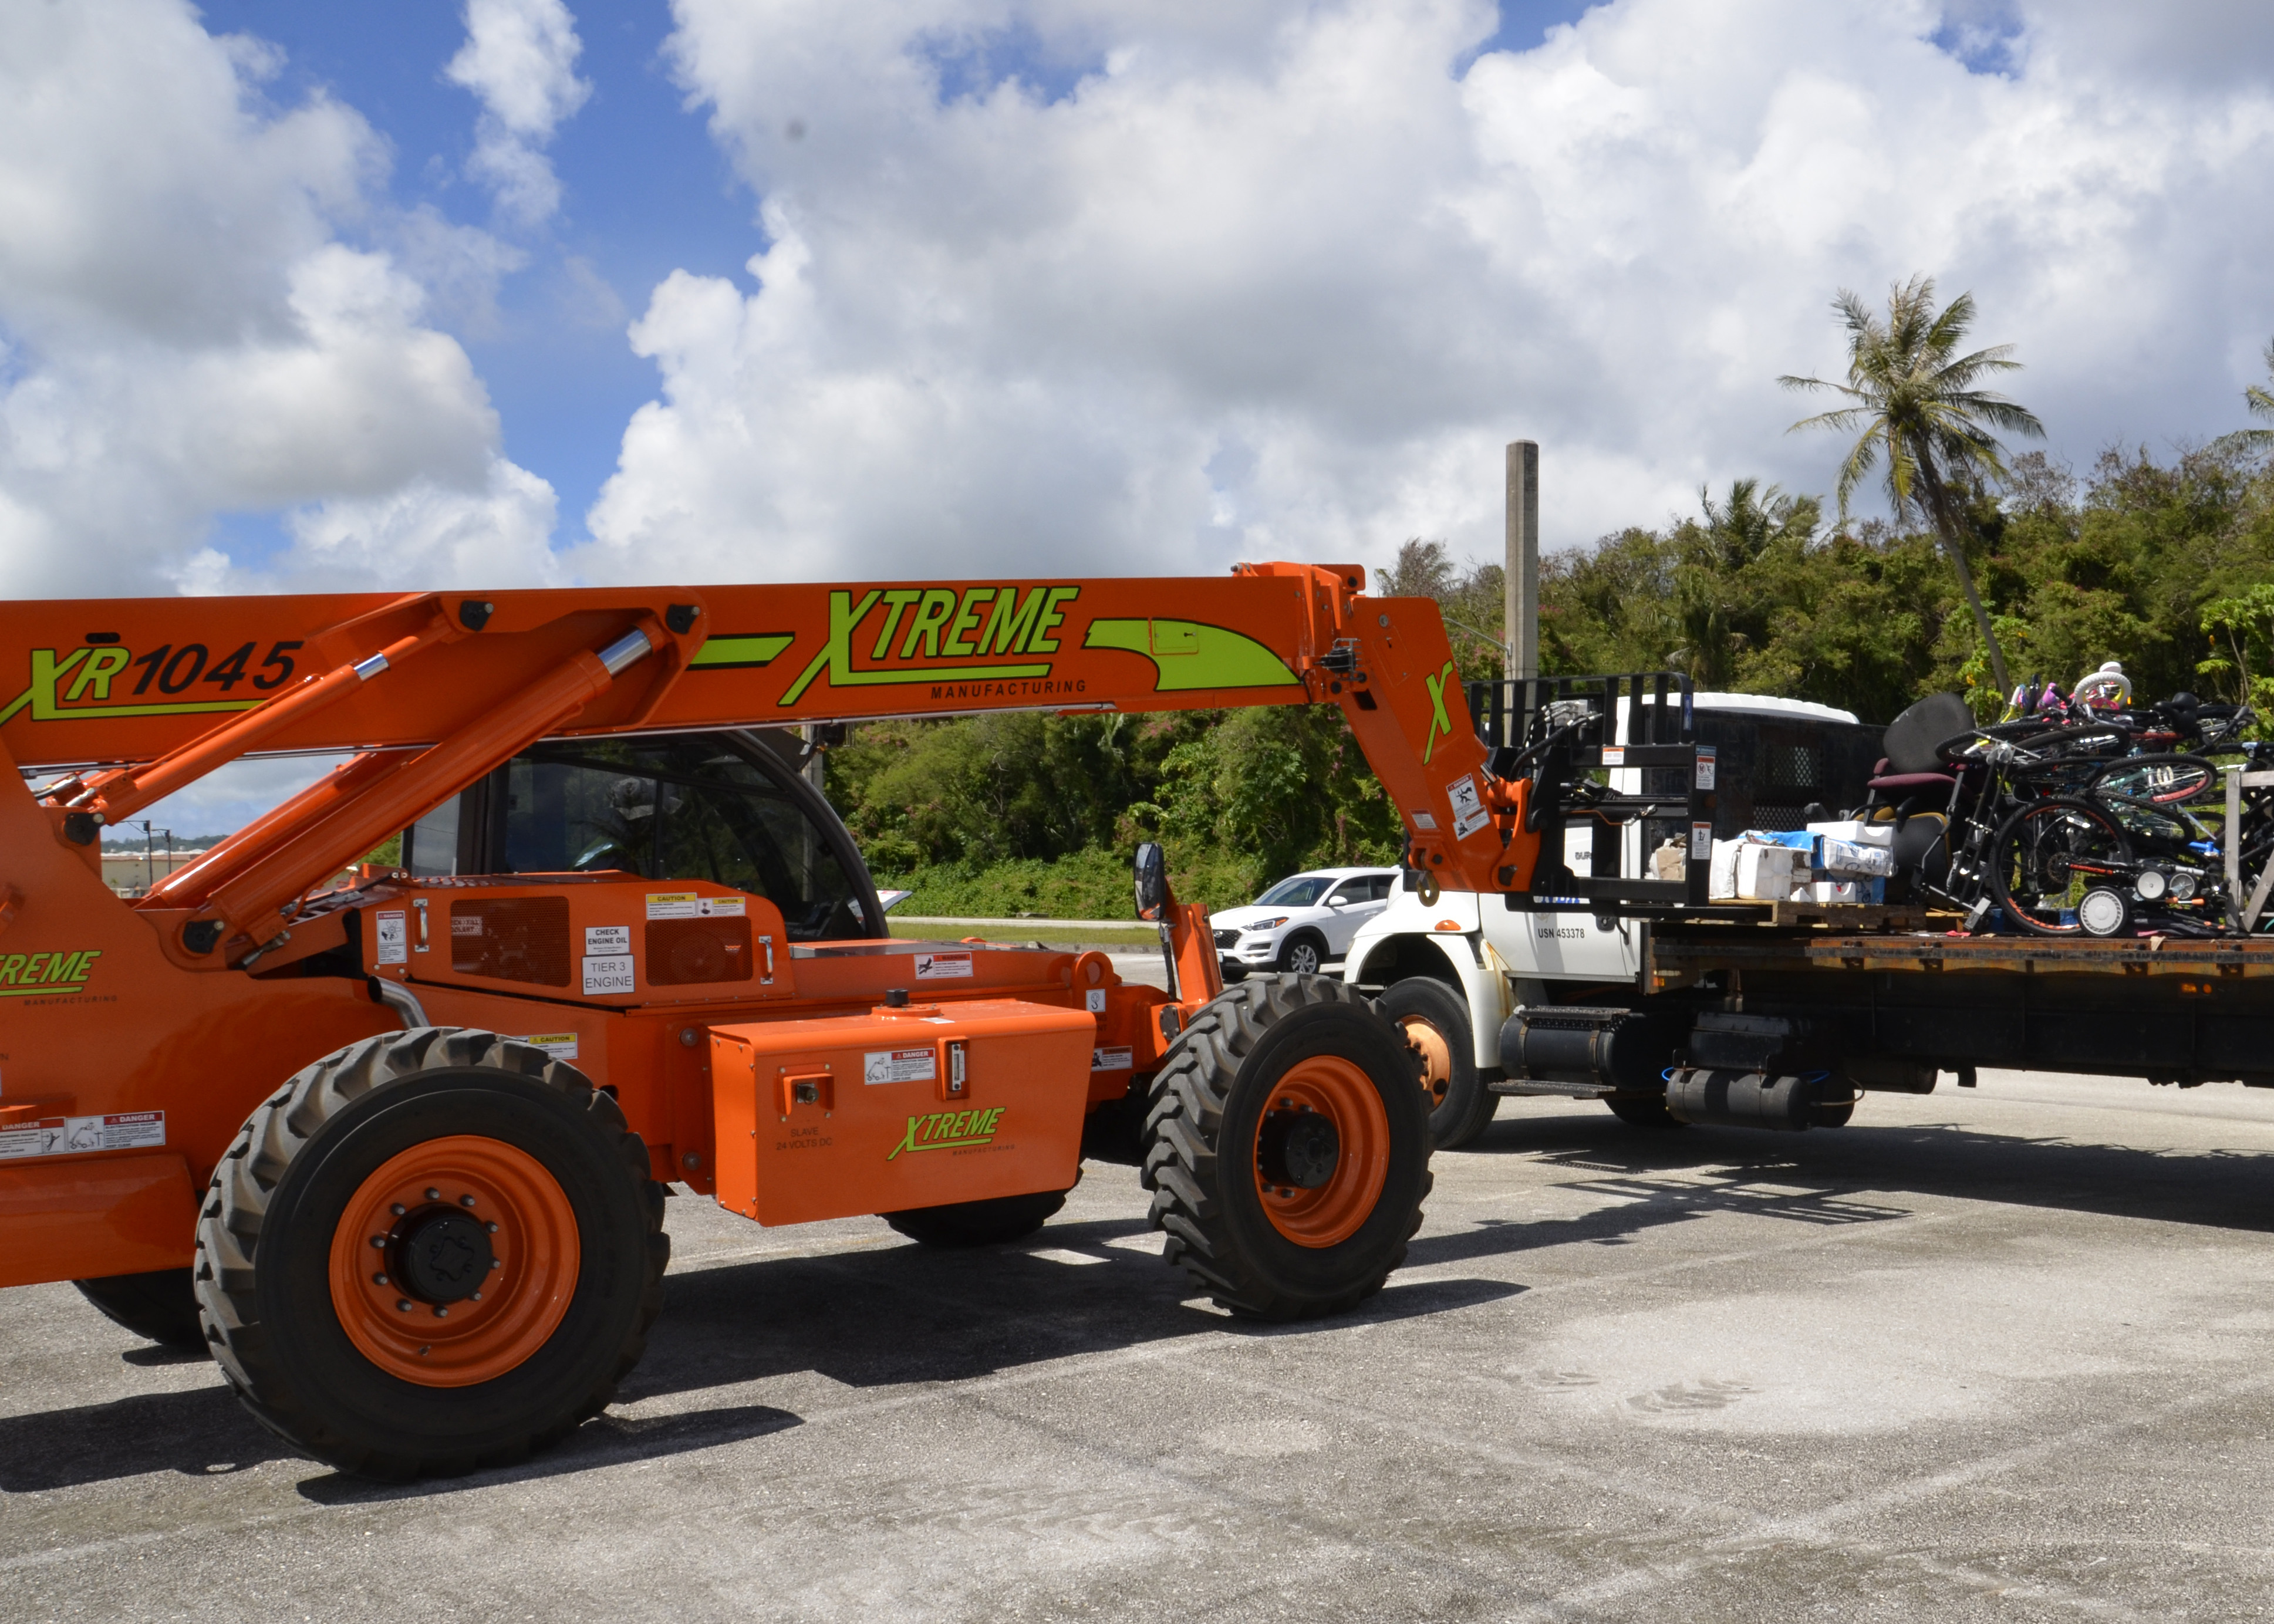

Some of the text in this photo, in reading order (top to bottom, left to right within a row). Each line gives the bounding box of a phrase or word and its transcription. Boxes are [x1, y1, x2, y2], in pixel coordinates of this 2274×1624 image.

[776, 586, 1081, 706] XTREME
[930, 680, 1087, 700] MANUFACTURING
[1538, 928, 1585, 938] USN 453378
[0, 950, 102, 985] REME
[591, 961, 626, 973] TIER 3
[585, 975, 632, 988] ENGINE
[24, 995, 117, 1006] MANUFACTURING
[119, 1114, 156, 1123] DANGER
[2, 1121, 41, 1131] DANGER
[790, 1127, 819, 1137] SLAVE
[886, 1107, 1006, 1161] XTREME
[777, 1137, 832, 1150] 24 VOLTS DC
[952, 1144, 1015, 1156] MANUFACTURING
